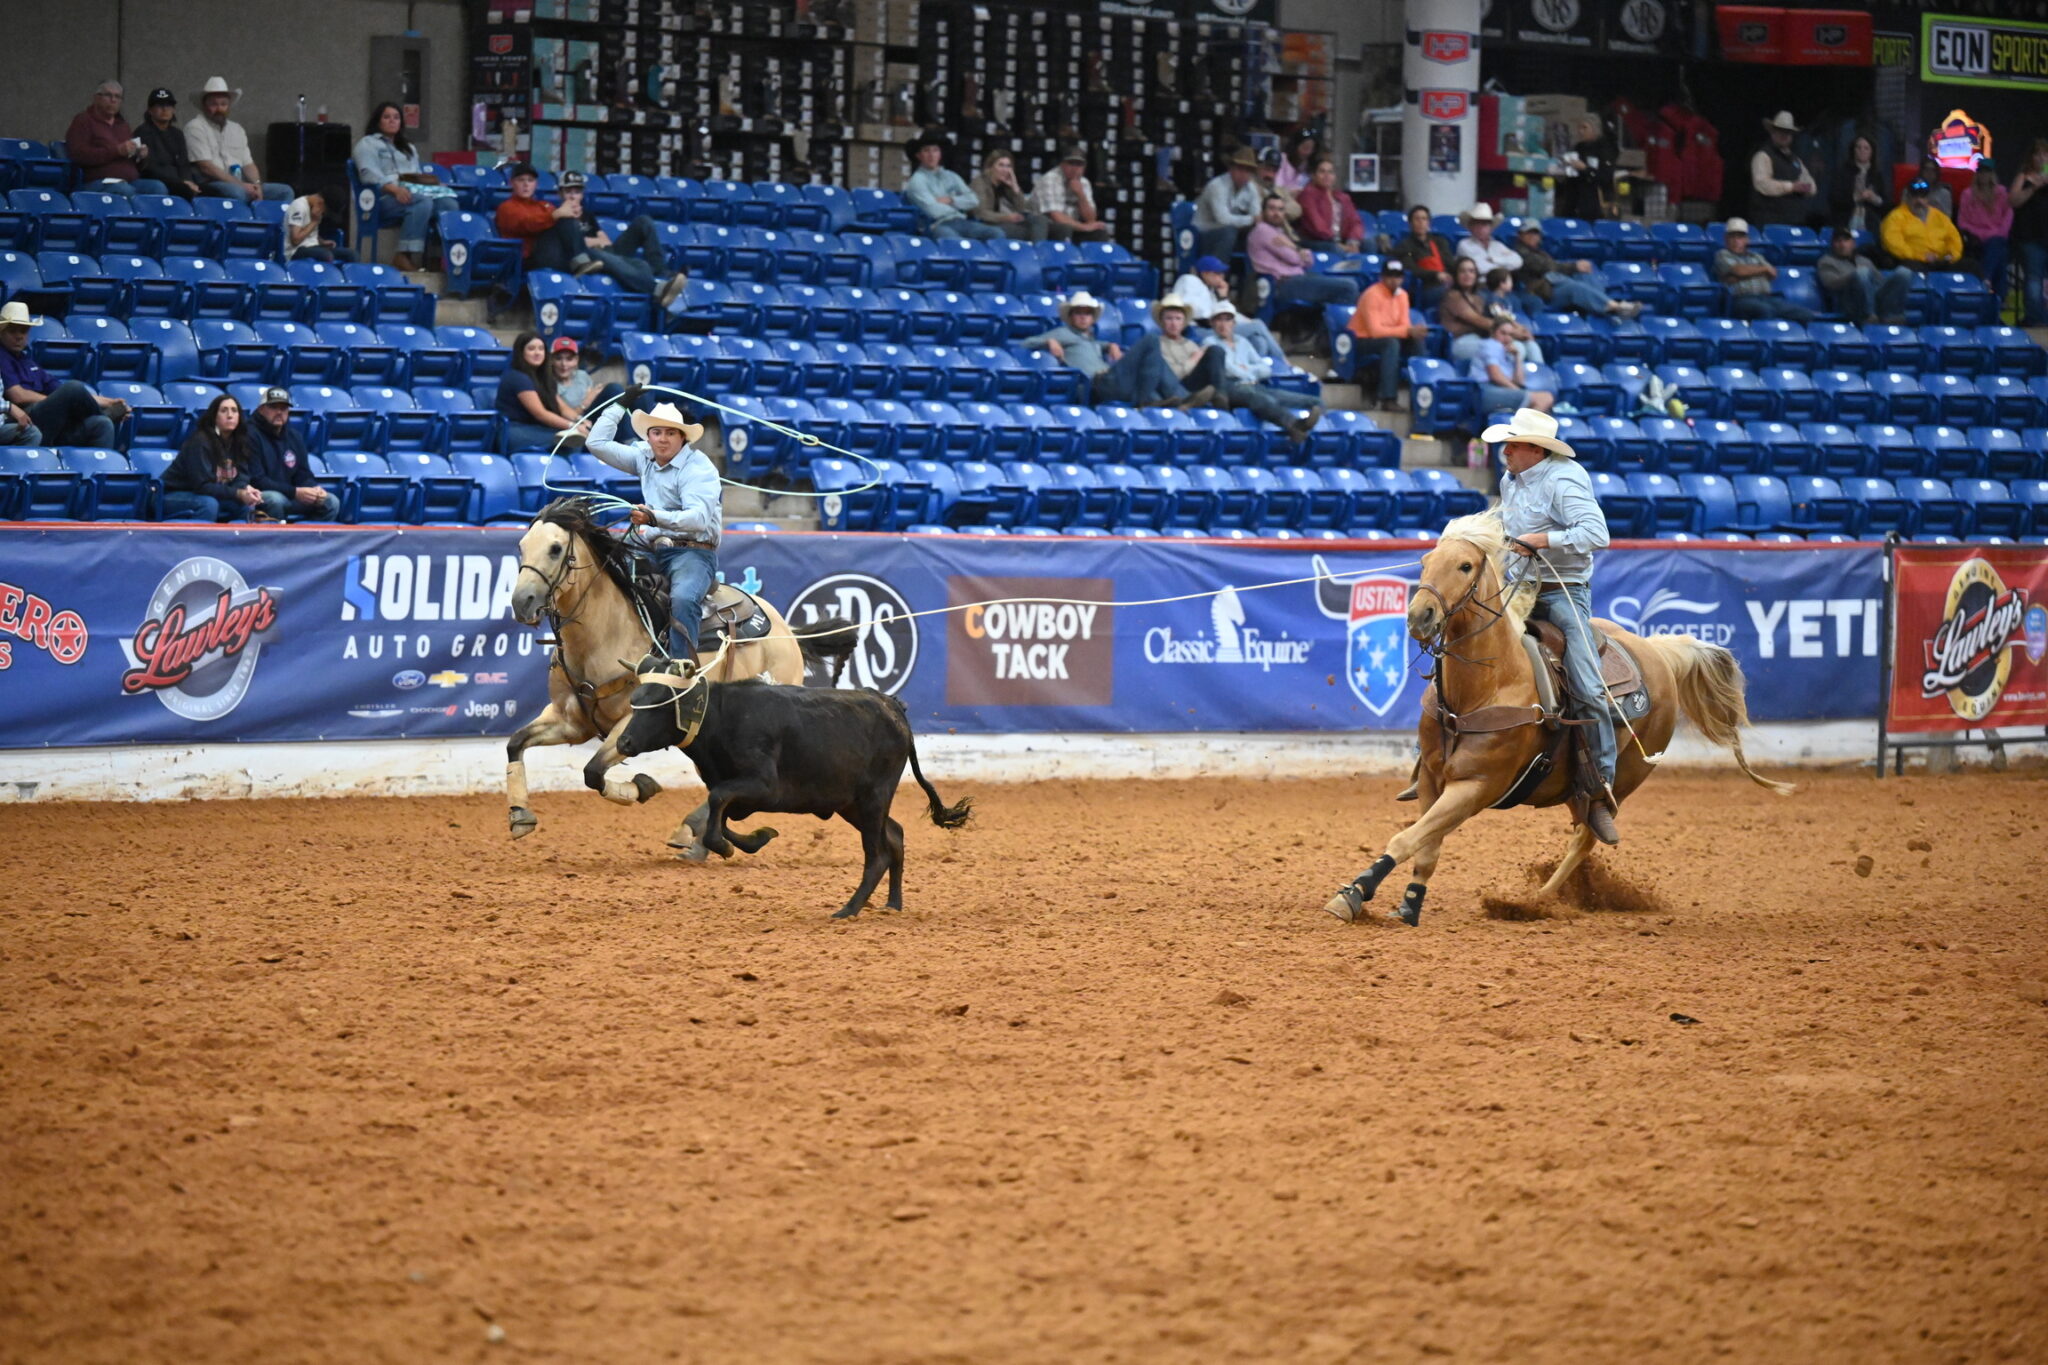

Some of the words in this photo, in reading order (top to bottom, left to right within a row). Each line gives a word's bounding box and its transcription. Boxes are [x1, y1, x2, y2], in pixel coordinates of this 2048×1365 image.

[1873, 37, 1911, 66] PORTS
[1936, 30, 1984, 71] EQN
[1992, 35, 2048, 75] SPORTS
[153, 564, 240, 613] GENUINE
[341, 555, 521, 621] HOLIDA
[1356, 586, 1404, 611] USTRC
[123, 588, 275, 691] Lawley's
[965, 604, 1097, 640] COWBOY
[1745, 599, 1878, 658] YETI
[1922, 590, 2023, 691] Lawley's
[343, 634, 431, 660] AUTO
[991, 643, 1070, 680] TACK
[1144, 626, 1215, 664] Classic
[1243, 628, 1309, 672] Equine
[464, 700, 500, 720] Jeep
